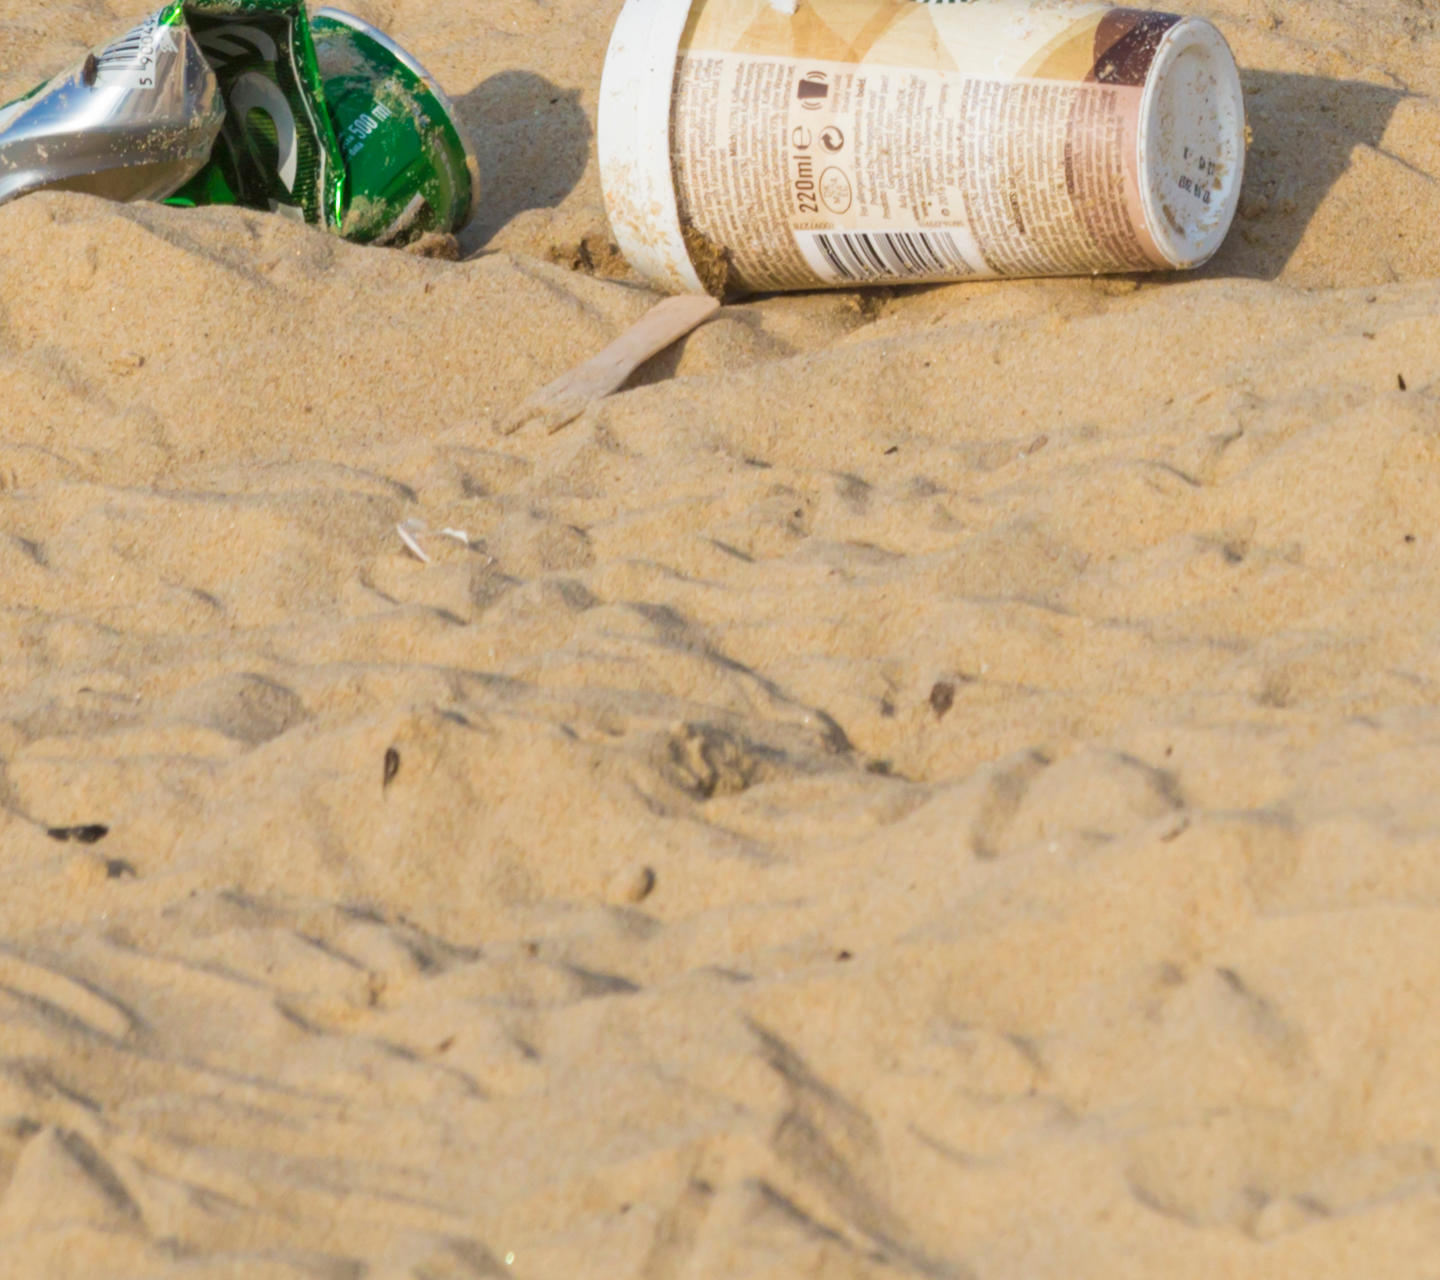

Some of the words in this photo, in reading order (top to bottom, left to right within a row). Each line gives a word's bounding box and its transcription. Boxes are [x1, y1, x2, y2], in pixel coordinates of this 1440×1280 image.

[346, 108, 381, 143] 500
[367, 98, 393, 124] ml
[792, 154, 818, 213] 220ml
